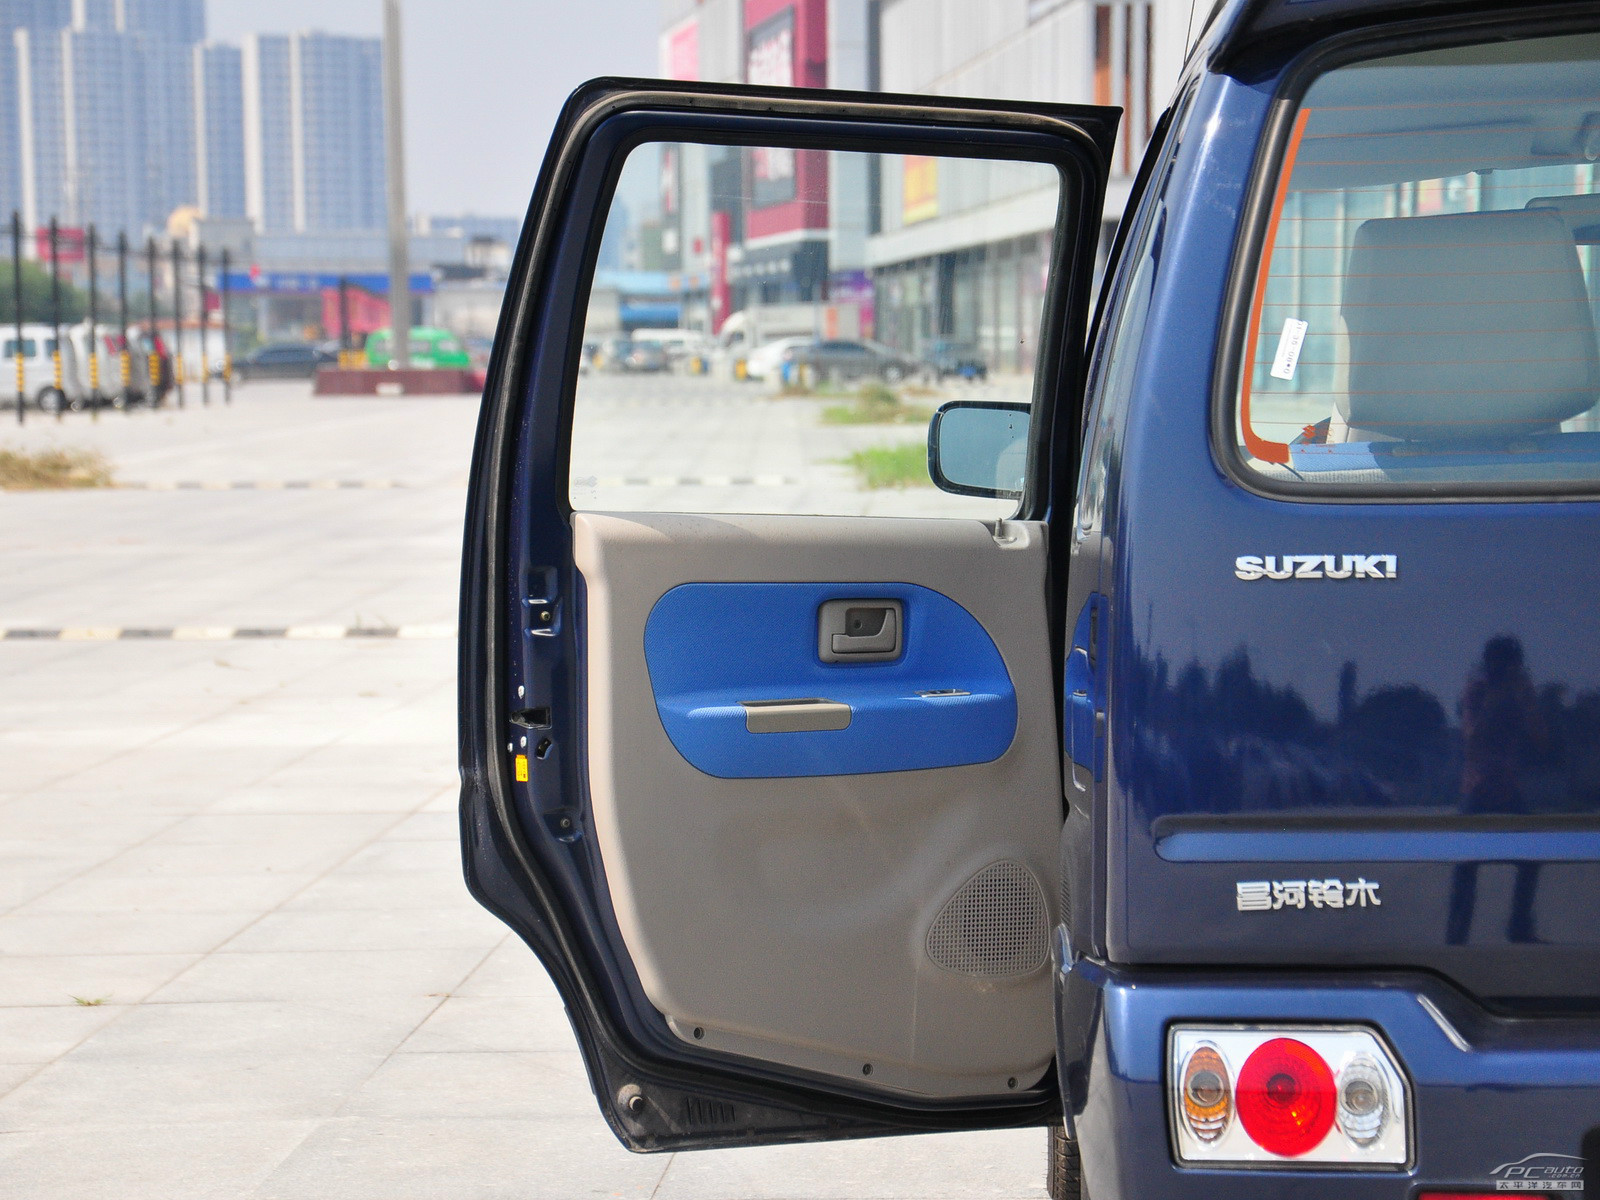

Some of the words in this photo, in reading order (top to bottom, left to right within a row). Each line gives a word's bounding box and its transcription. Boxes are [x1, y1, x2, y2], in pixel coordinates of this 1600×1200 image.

[1235, 554, 1397, 580] SUZUKI
[1236, 877, 1382, 911] 昌河铃木
